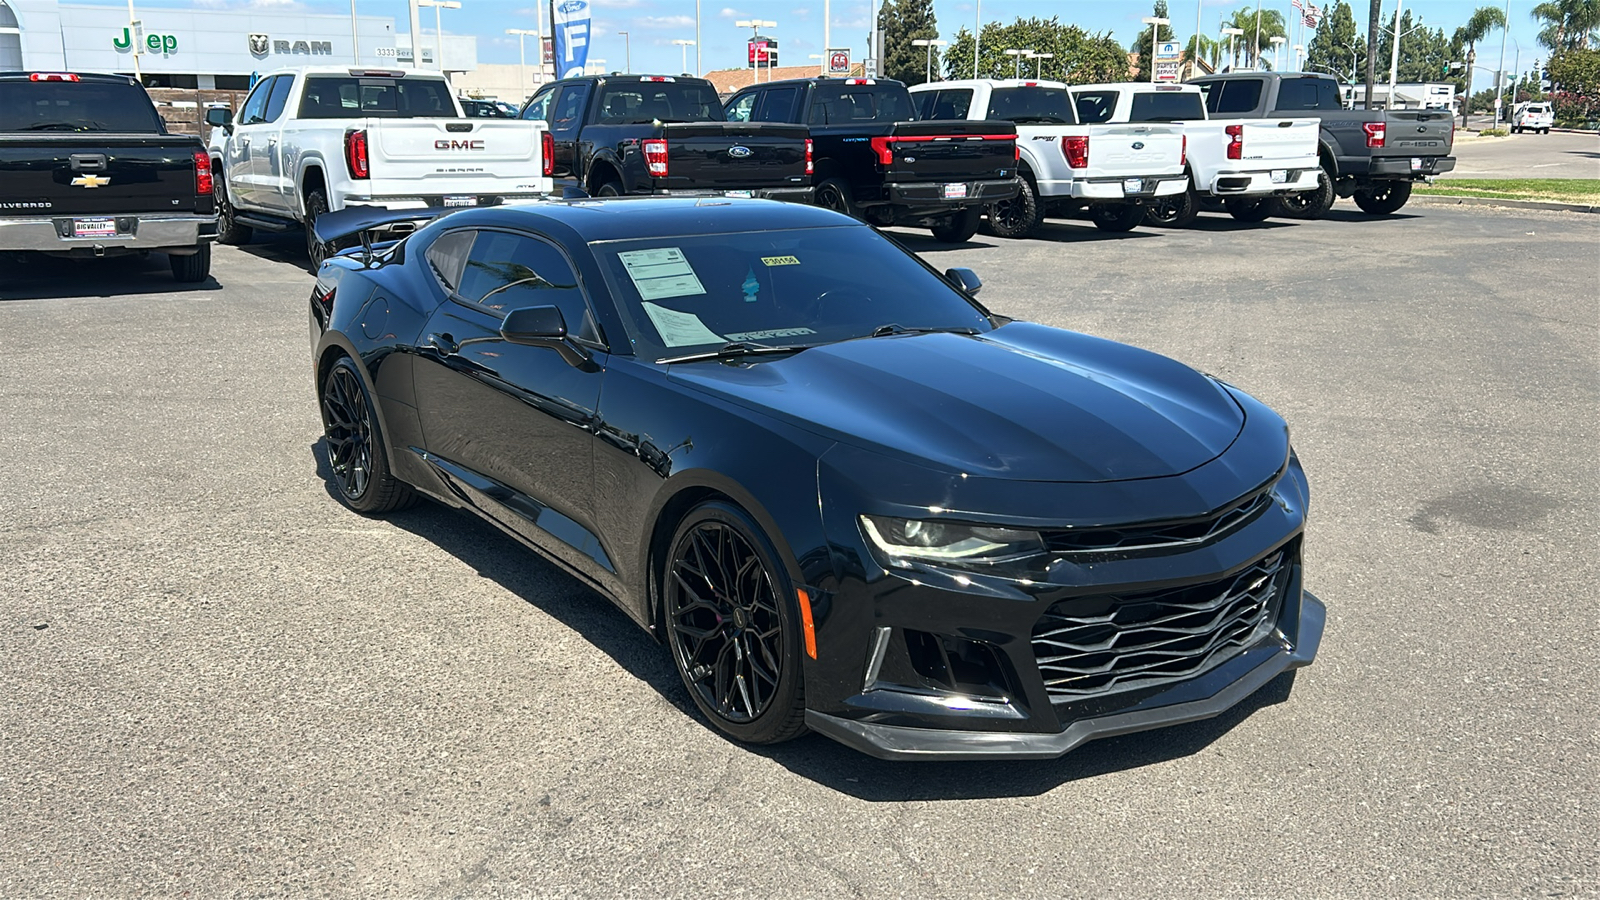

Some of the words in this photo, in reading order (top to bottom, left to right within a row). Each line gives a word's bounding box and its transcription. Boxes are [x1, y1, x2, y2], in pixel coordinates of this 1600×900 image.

[113, 27, 178, 53] Jep
[273, 39, 332, 56] RAM
[377, 48, 395, 57] 3333
[434, 140, 485, 151] GMC
